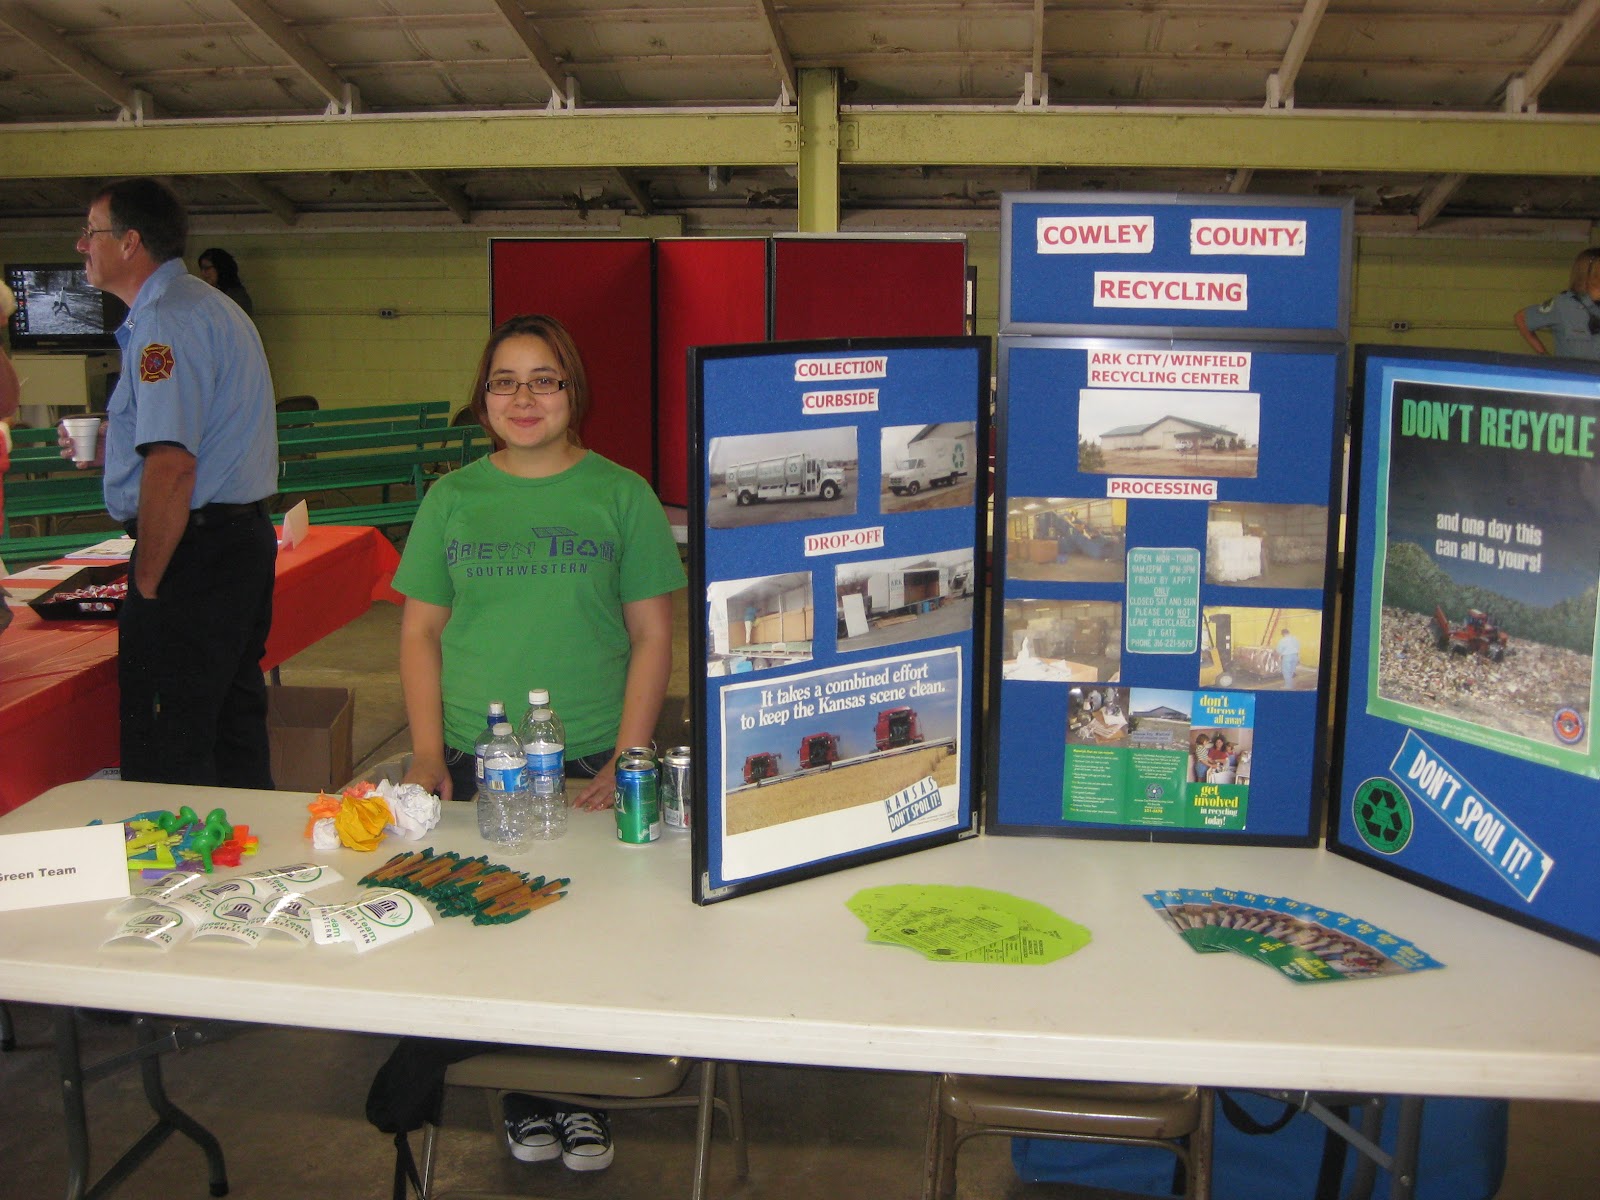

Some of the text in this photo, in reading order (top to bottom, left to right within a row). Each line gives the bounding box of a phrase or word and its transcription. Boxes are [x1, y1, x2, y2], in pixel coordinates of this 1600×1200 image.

[1043, 224, 1300, 247] COWLEY COUNTY
[1099, 279, 1243, 303] RECYCLING
[797, 359, 884, 377] COLLECTION
[1091, 352, 1248, 369] ARK CITY/WINFIELD
[1091, 370, 1240, 385] RECYCLING CENTER
[804, 391, 876, 409] CURBSIDE
[1401, 398, 1597, 459] DON'T RECYCLE
[1110, 481, 1214, 496] PROCESSING
[1436, 512, 1543, 547] and one day this
[806, 528, 882, 552] DROP-OFF
[1133, 553, 1152, 563] OPEN
[1435, 538, 1542, 574] can all be yours!
[466, 563, 588, 578] SOUTHWESTERN
[1134, 575, 1157, 584] FRIDAY
[1160, 576, 1169, 584] BY
[1153, 586, 1171, 597] ONLY
[1129, 597, 1155, 606] CLOSED
[1168, 597, 1182, 606] AND
[1183, 597, 1197, 606] SUN
[1135, 607, 1191, 618] PLEASE DO NOT
[1129, 618, 1196, 628] LEAVE RECYCLABLES
[1147, 629, 1177, 637] BY GATE
[1131, 639, 1152, 648] PHONE
[760, 662, 930, 709] It takes a combined effort
[740, 680, 946, 731] to keep the Kansas scene clean.
[1199, 694, 1229, 708] don't
[1206, 706, 1246, 716] throw it
[1213, 714, 1246, 728] all away!
[884, 776, 935, 814] KANSAS
[1200, 784, 1219, 798] get
[1193, 794, 1239, 808] involved
[889, 807, 911, 831] DON'T
[910, 797, 931, 819] SPOIL
[1200, 806, 1238, 817] in recycling
[1407, 749, 1462, 811] DON'T
[1454, 794, 1506, 856] SPOIL
[1500, 836, 1534, 881] IT!
[1204, 815, 1226, 828] today!
[38, 866, 77, 878] Team
